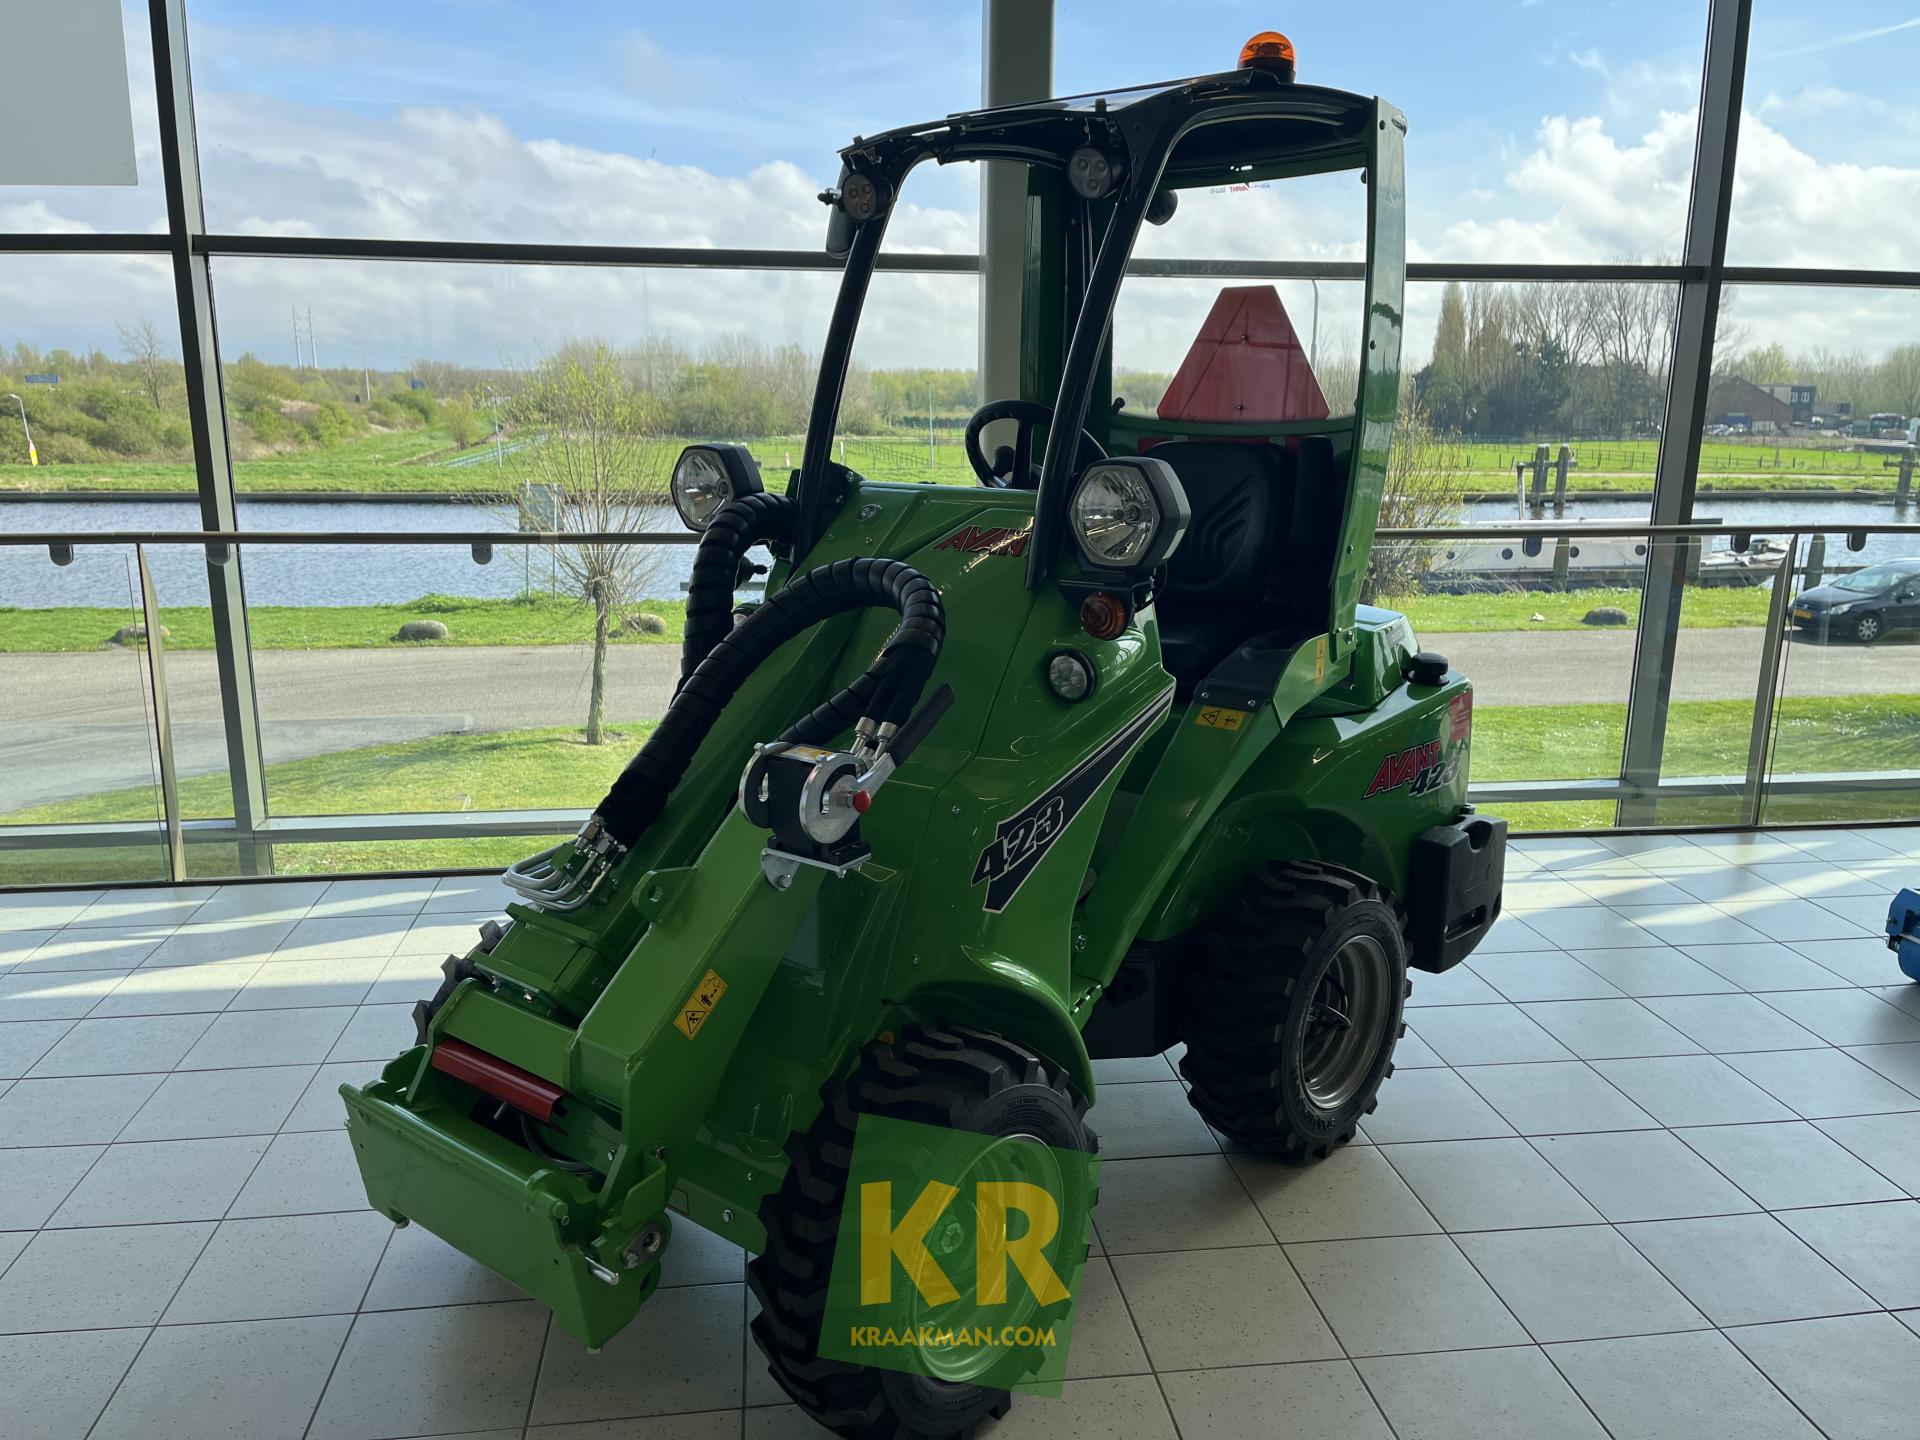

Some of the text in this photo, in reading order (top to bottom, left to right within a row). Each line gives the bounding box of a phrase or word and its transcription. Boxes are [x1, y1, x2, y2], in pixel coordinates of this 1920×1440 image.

[932, 525, 1031, 558] AVAN
[1361, 739, 1441, 800] AVANT
[1408, 759, 1460, 797] 423
[971, 796, 1064, 887] 423
